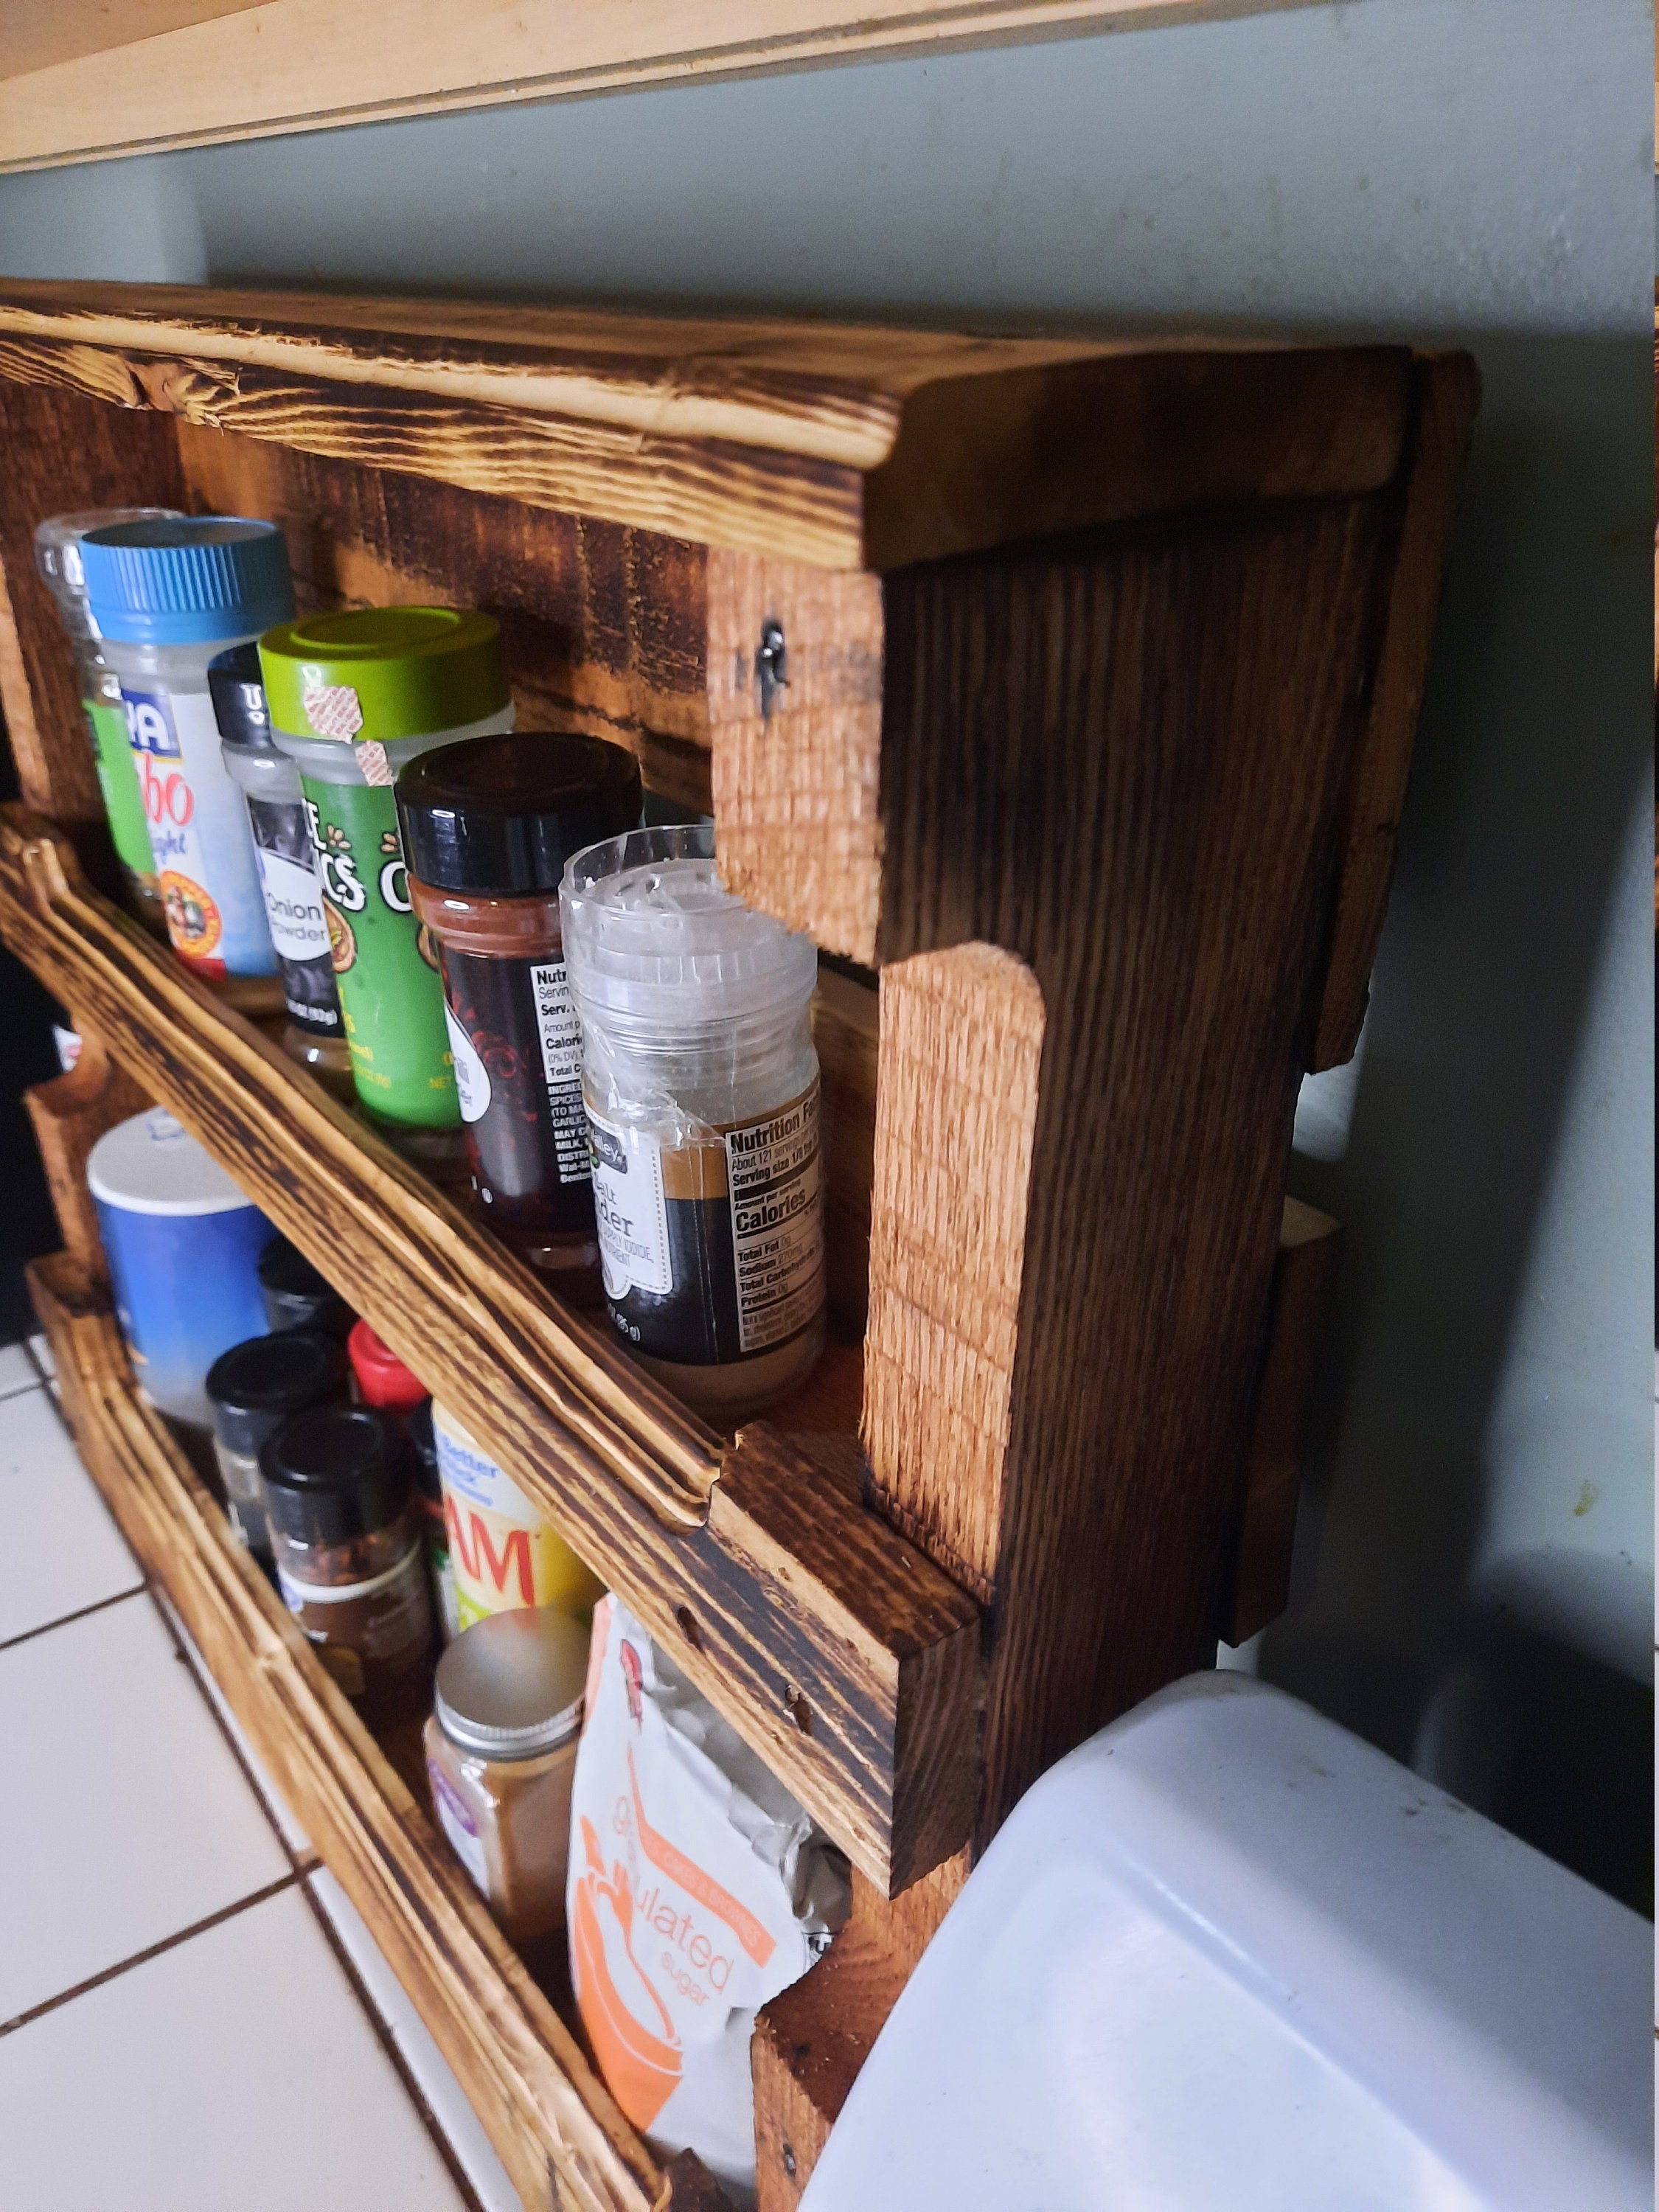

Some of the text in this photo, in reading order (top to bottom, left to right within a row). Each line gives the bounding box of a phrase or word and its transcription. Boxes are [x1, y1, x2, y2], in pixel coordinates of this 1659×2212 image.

[267, 891, 321, 921] Onion
[536, 968, 567, 986] Nutr
[538, 986, 570, 1000] Servin
[541, 1003, 570, 1016] Serv.
[546, 1033, 582, 1050] Calori
[549, 1062, 581, 1077] Total C
[568, 1103, 585, 1116] MA
[554, 1128, 577, 1140] MAY
[730, 1112, 801, 1155] Nutrition
[557, 1149, 590, 1163] DISTRI
[731, 1155, 757, 1172] About
[759, 1148, 773, 1165] 121
[732, 1166, 771, 1187] Serving
[772, 1157, 790, 1175] size
[735, 1189, 806, 1233] Calories
[737, 1246, 762, 1262] Total
[764, 1239, 779, 1255] Fat
[739, 1258, 776, 1277] Sodium
[740, 1276, 764, 1293] Total
[741, 1288, 777, 1307] Protein
[661, 1951, 711, 2006] sugar
